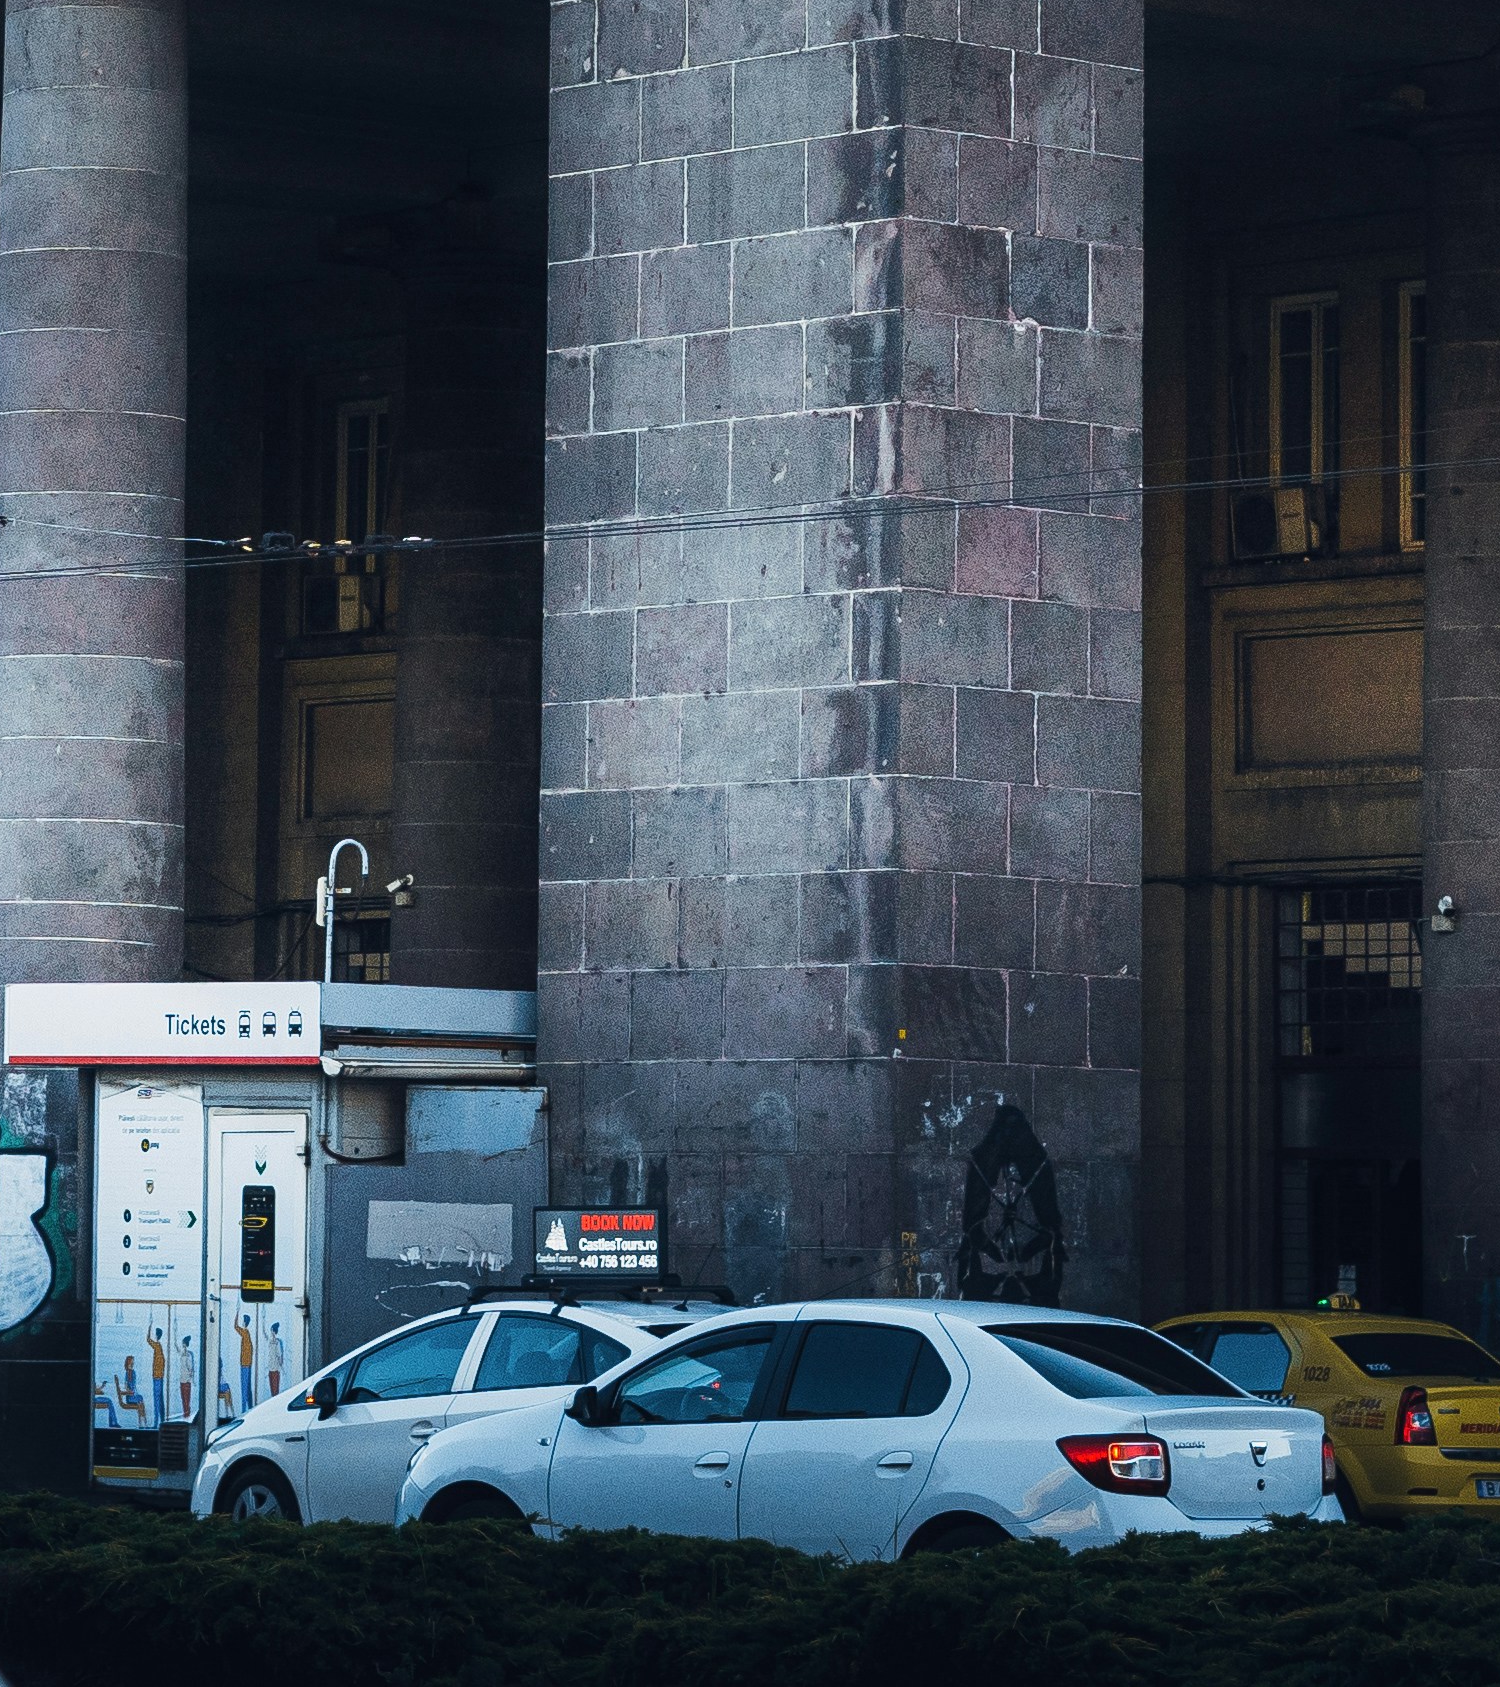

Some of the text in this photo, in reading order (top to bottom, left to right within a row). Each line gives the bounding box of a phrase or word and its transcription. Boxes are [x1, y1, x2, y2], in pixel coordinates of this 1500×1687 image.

[164, 1013, 226, 1036] Tickets
[580, 1214, 655, 1231] BOOK NOW
[578, 1237, 658, 1252] CastlesTours.ro
[579, 1255, 658, 1268] +40 756 123 456
[1303, 1365, 1331, 1382] 1028
[1486, 1481, 1495, 1496] B
